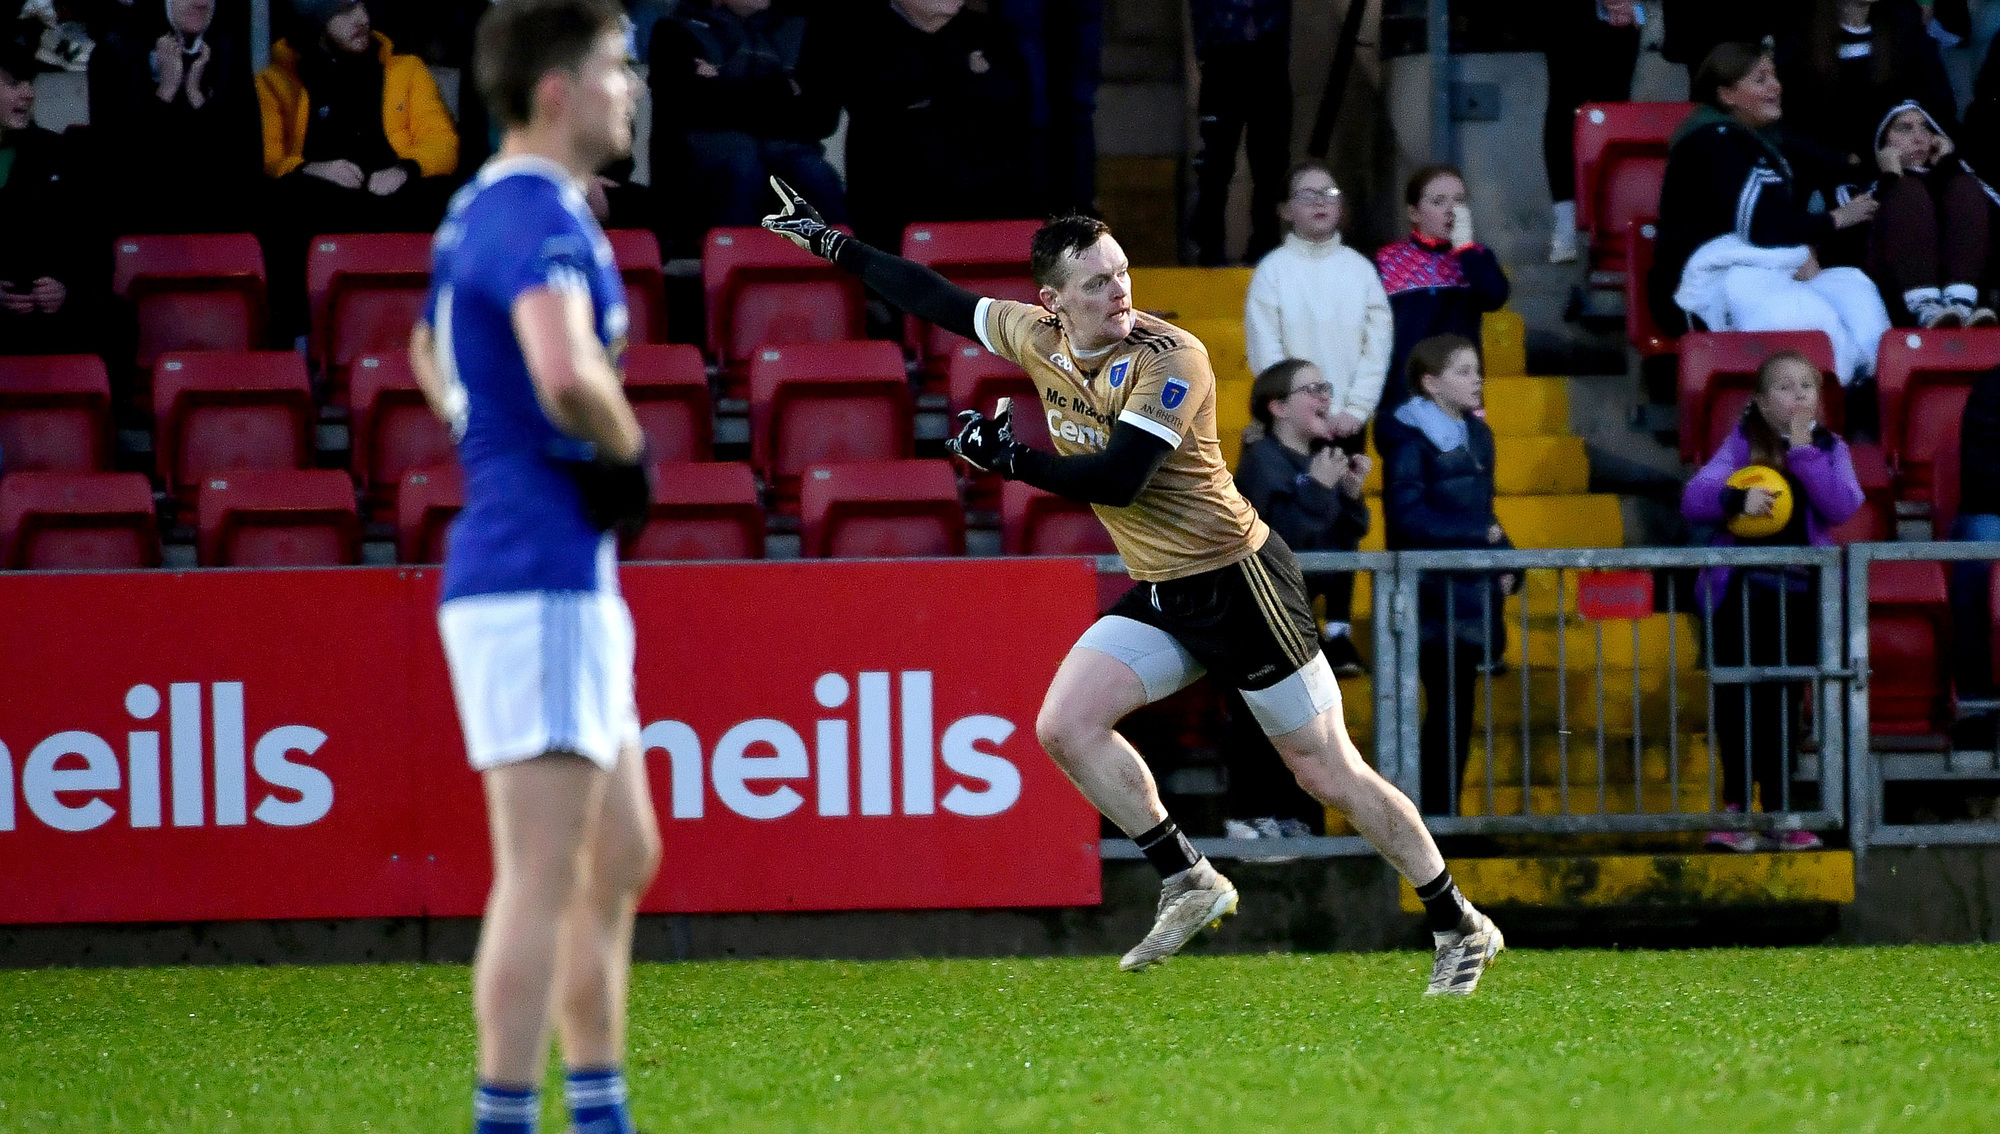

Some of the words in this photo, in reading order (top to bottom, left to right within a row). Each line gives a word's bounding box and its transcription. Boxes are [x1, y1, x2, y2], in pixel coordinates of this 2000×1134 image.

[1046, 387, 1067, 407] Mc
[1141, 404, 1156, 415] AN
[0, 682, 334, 832] eills
